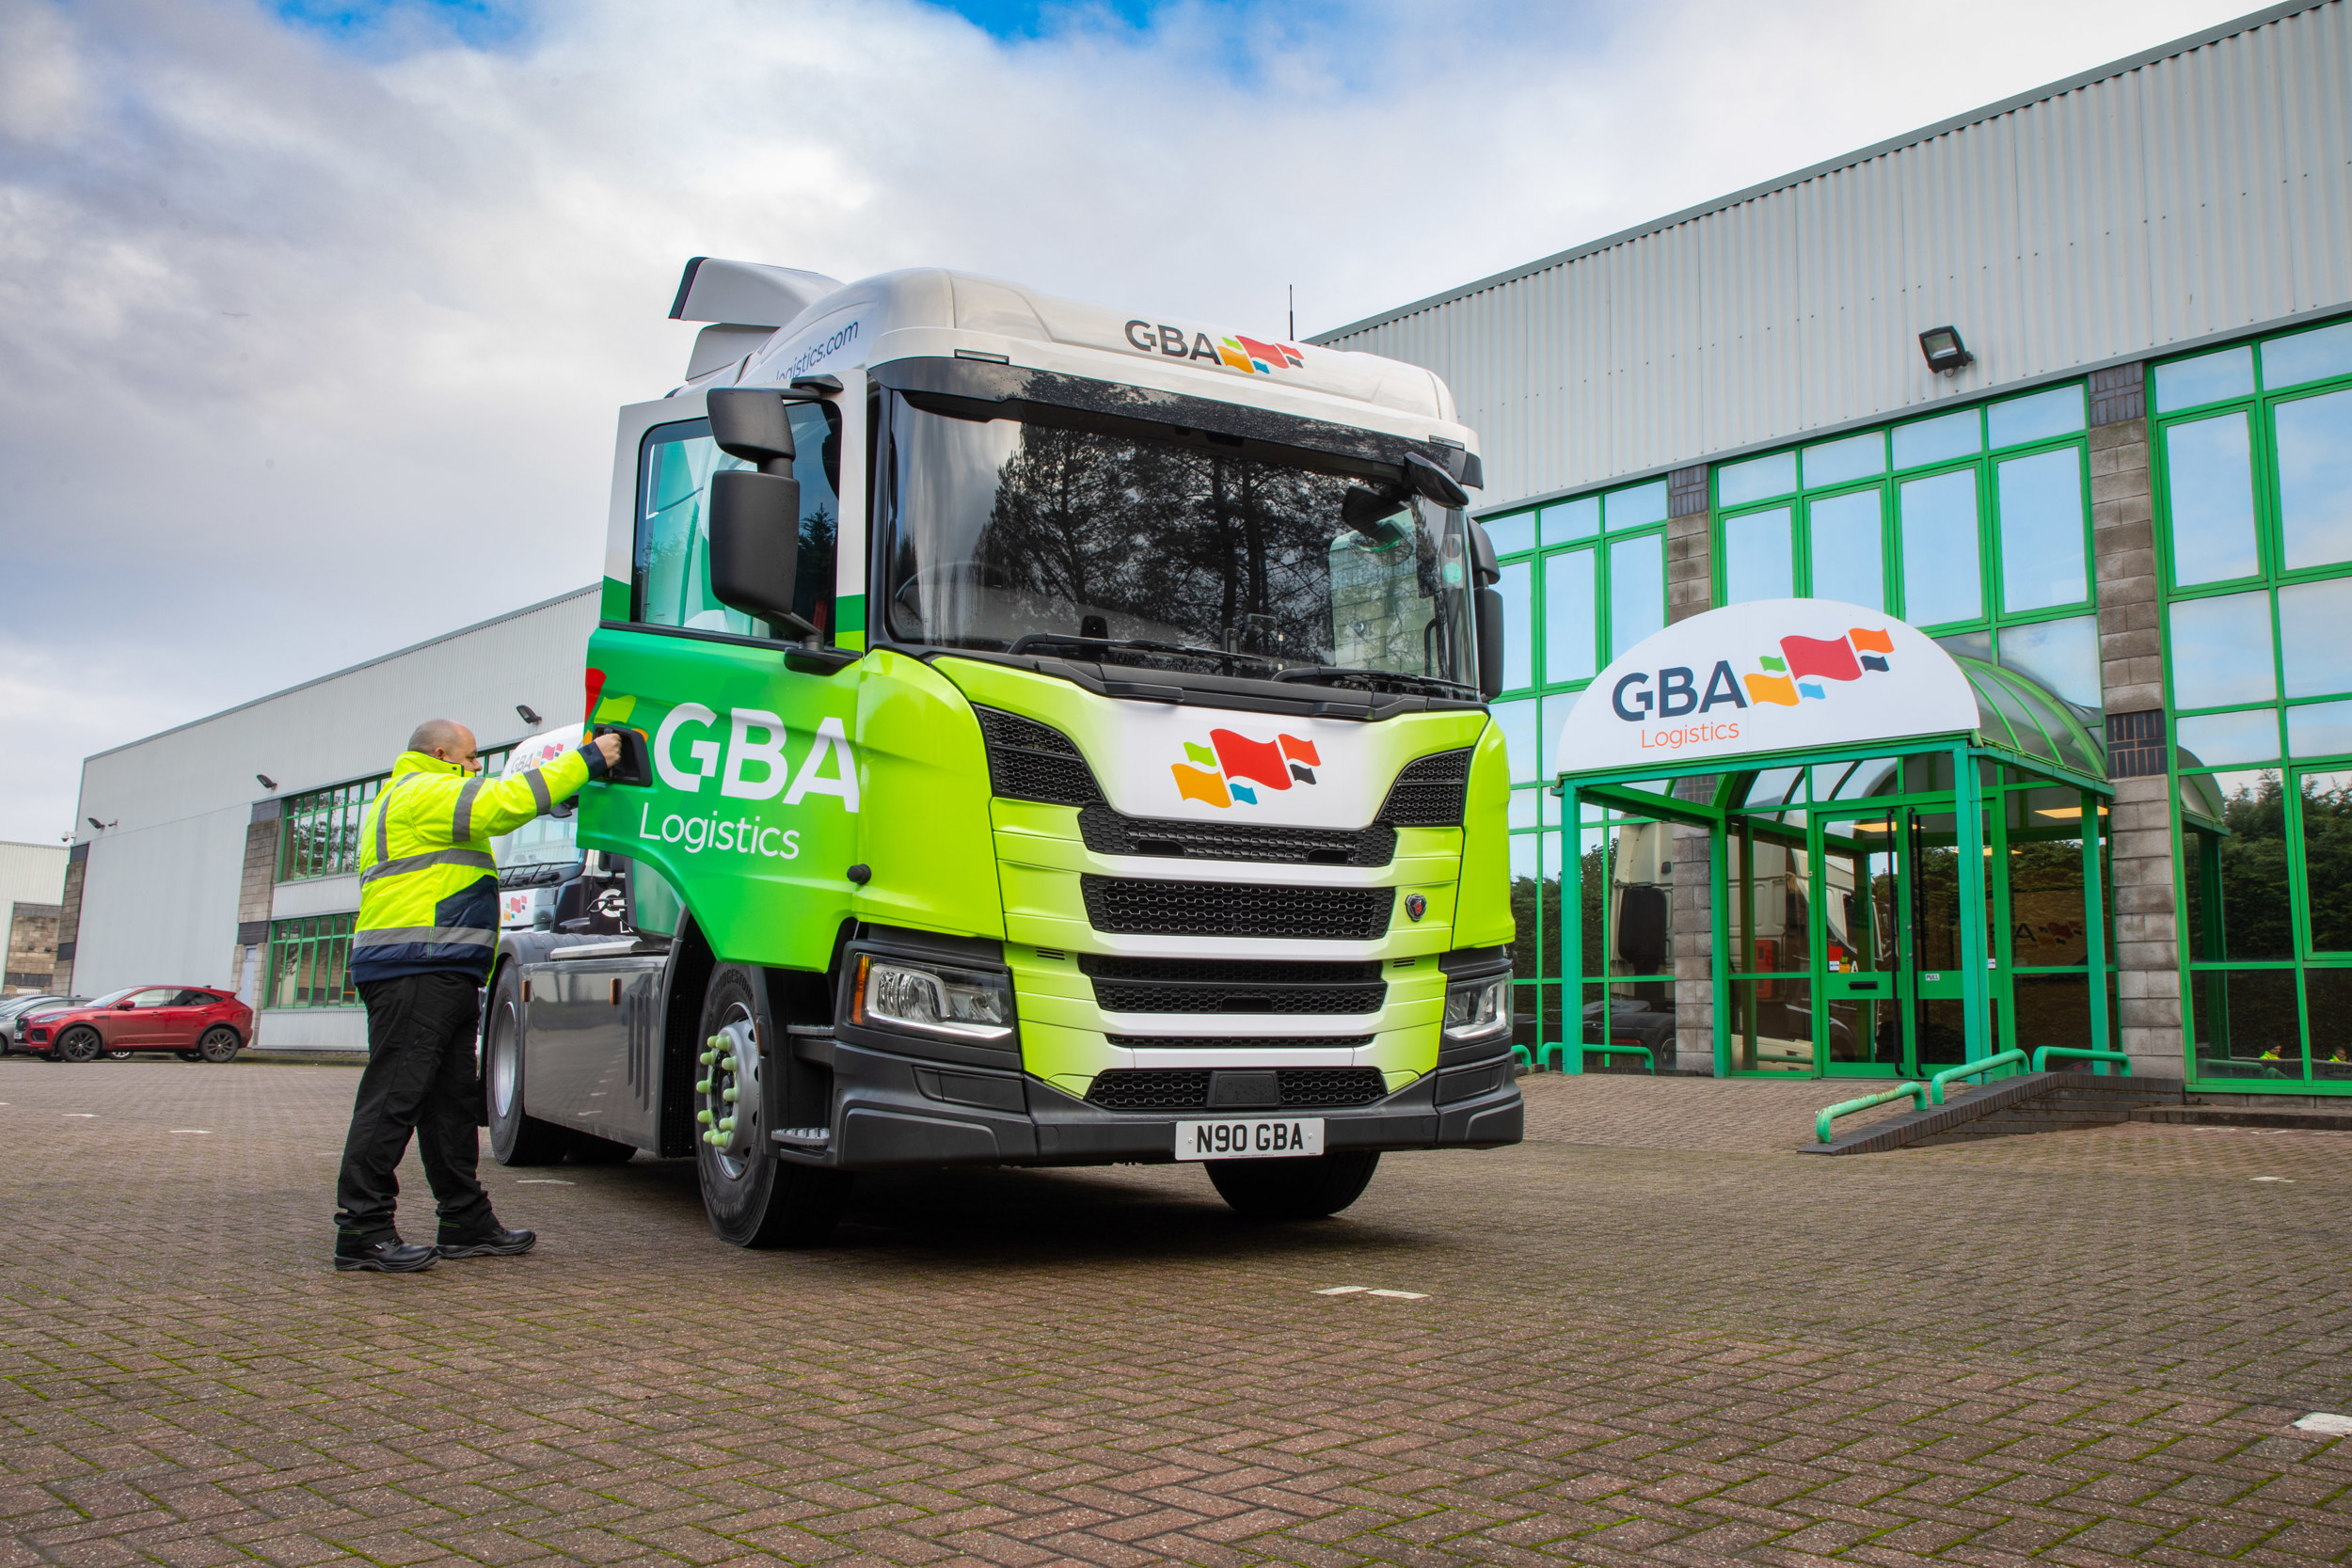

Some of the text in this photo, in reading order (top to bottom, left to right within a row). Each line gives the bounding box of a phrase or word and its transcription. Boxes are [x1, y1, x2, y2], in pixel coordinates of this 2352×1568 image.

[1124, 320, 1222, 366] GBA
[1612, 660, 1748, 721] GBA
[654, 702, 860, 813] GBA
[1642, 721, 1740, 749] Logistics
[640, 802, 801, 860] Logistics
[1197, 1122, 1304, 1153] N90 GBA
